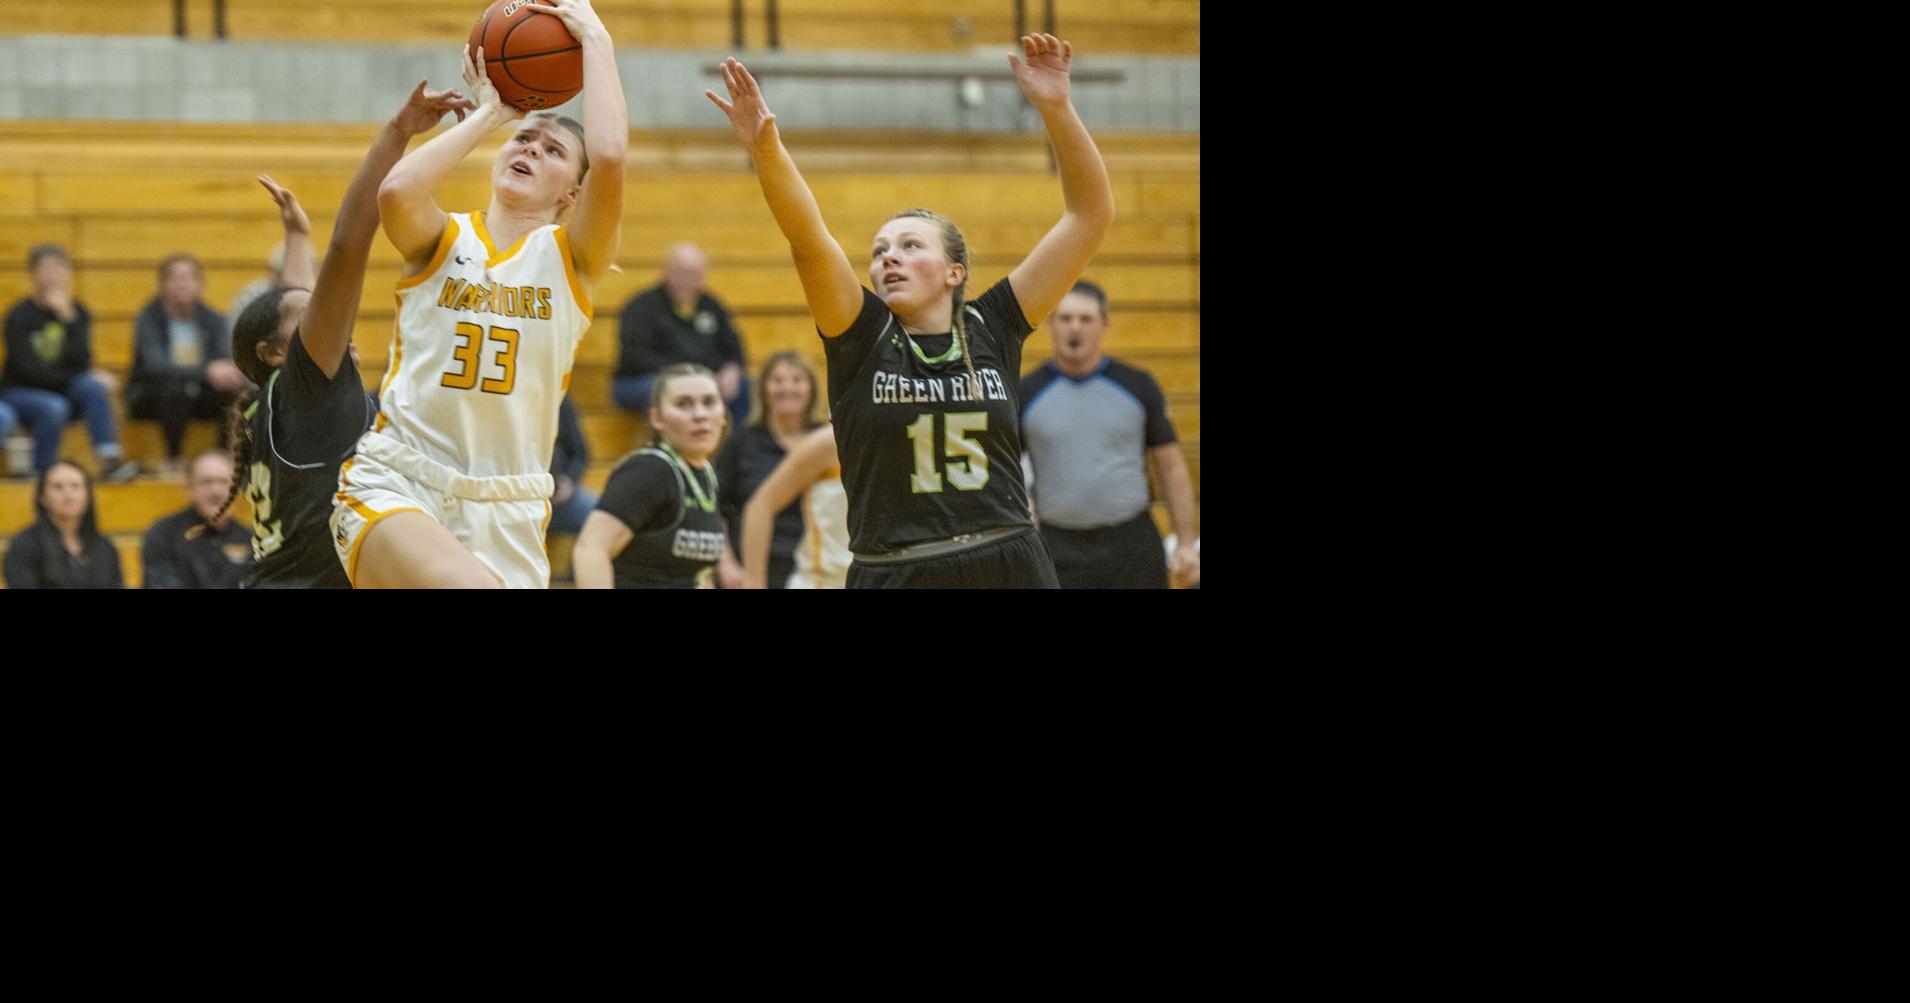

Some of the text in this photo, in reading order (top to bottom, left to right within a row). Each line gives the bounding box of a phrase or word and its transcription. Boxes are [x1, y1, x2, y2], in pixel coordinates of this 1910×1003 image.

[438, 276, 552, 320] WARRIORS
[440, 321, 521, 395] 33
[872, 370, 945, 404] GREEN
[906, 411, 990, 494] 15
